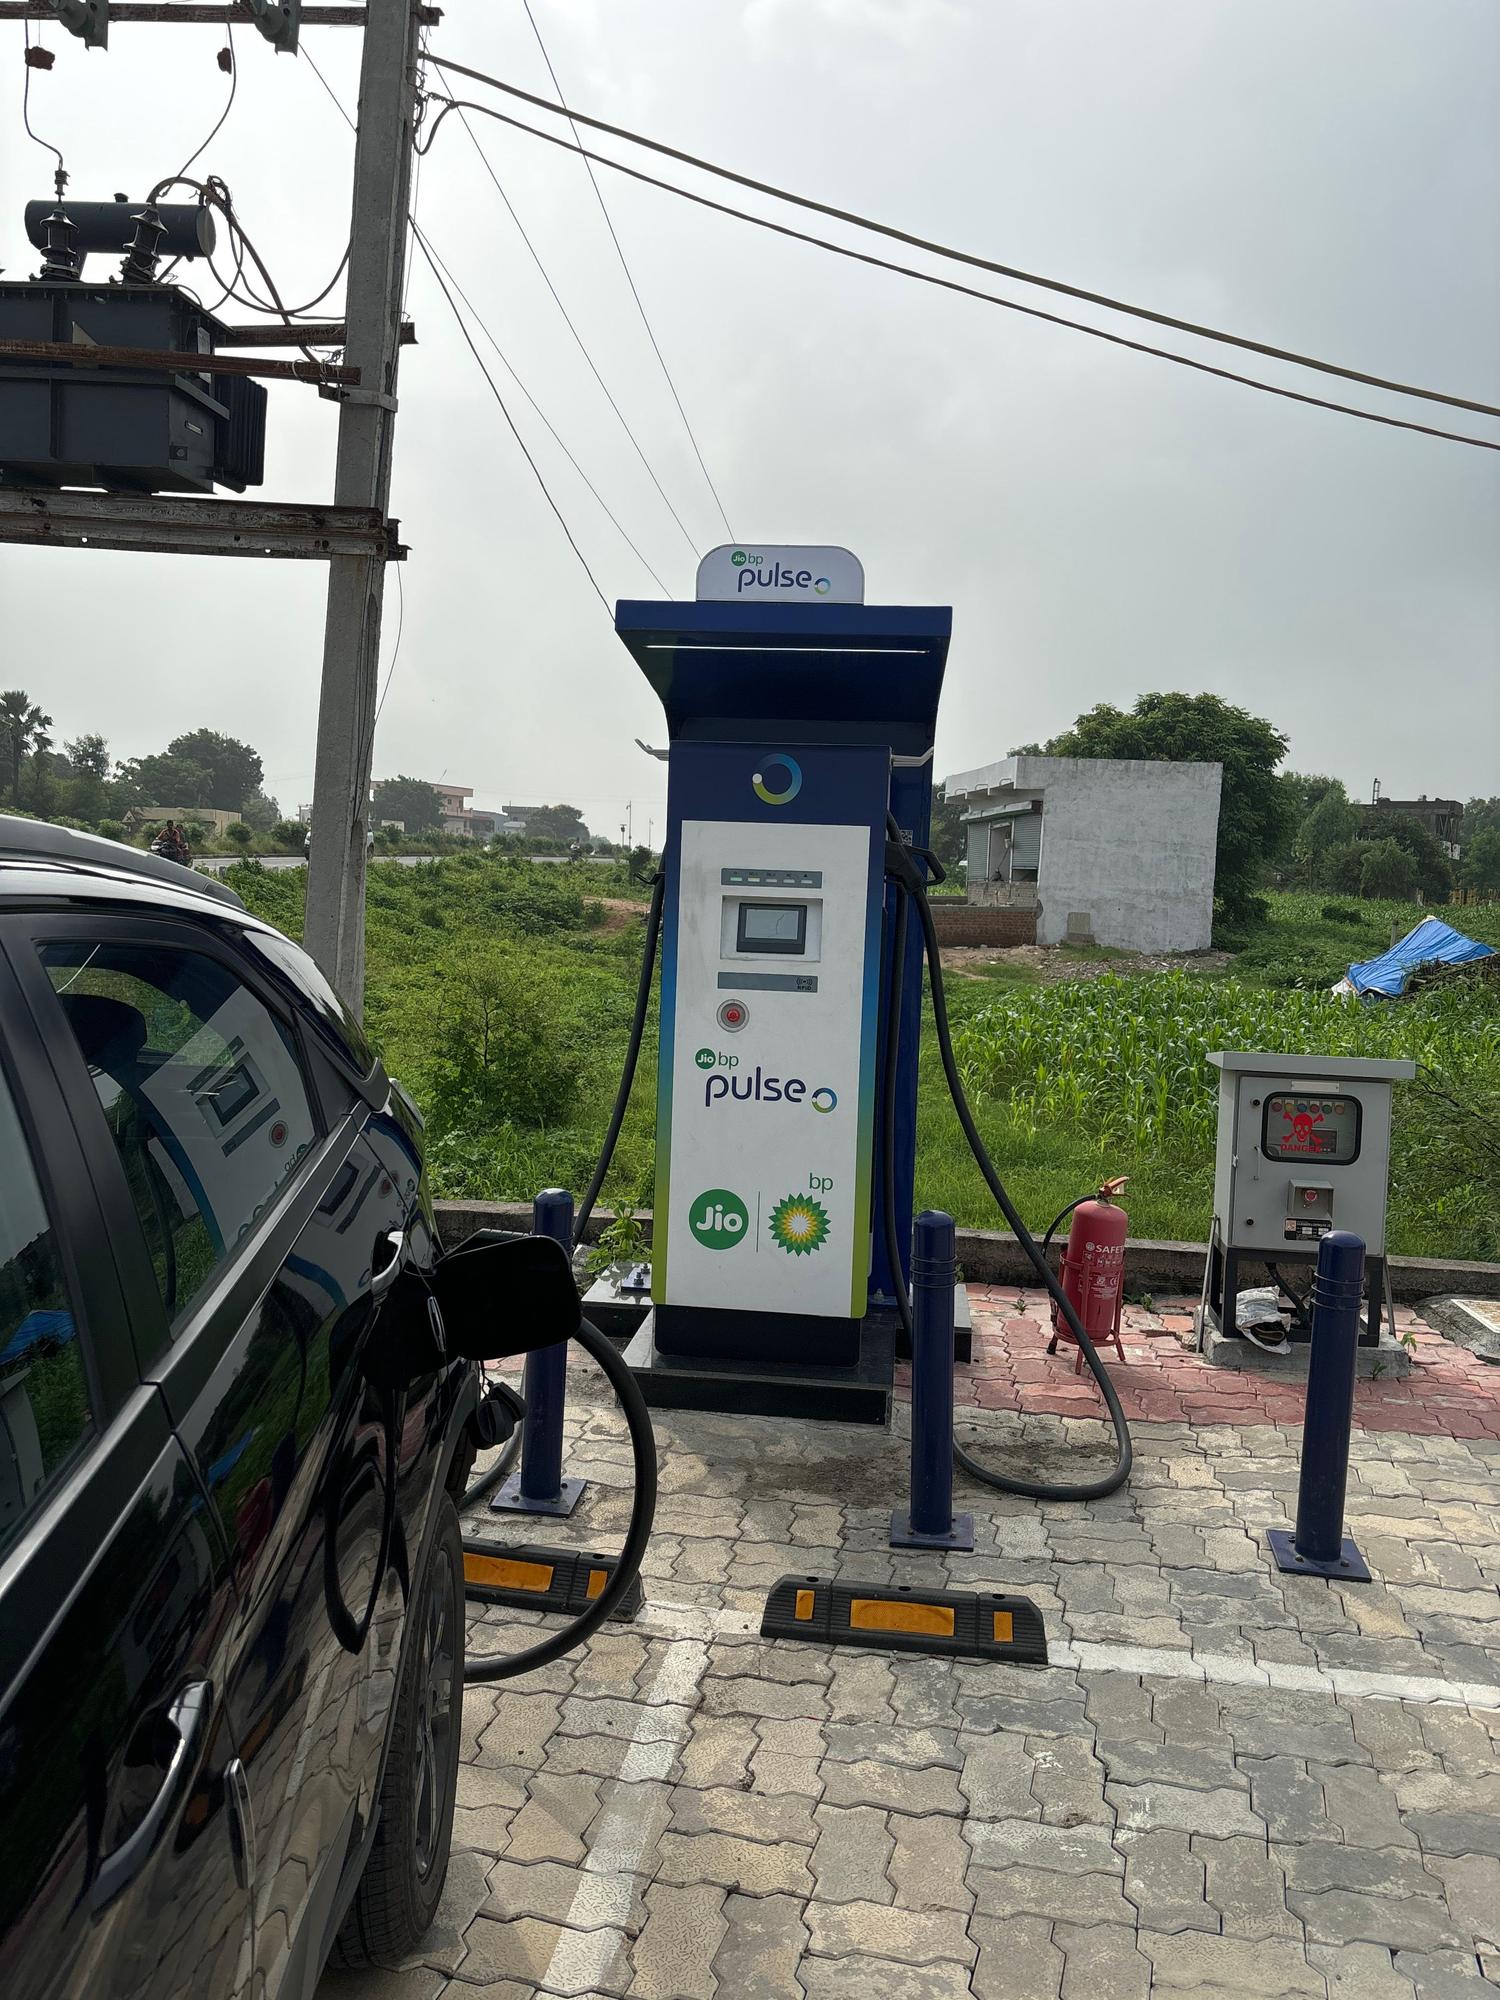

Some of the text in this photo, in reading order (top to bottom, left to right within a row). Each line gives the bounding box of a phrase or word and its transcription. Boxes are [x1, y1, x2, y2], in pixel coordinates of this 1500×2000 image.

[748, 553, 763, 566] bp
[738, 562, 812, 592] pulse
[697, 1052, 739, 1070] Jio bp
[705, 1066, 806, 1107] pulse
[1280, 1143, 1322, 1153] DANGER
[809, 1172, 834, 1194] bp
[696, 1204, 743, 1232] Jio
